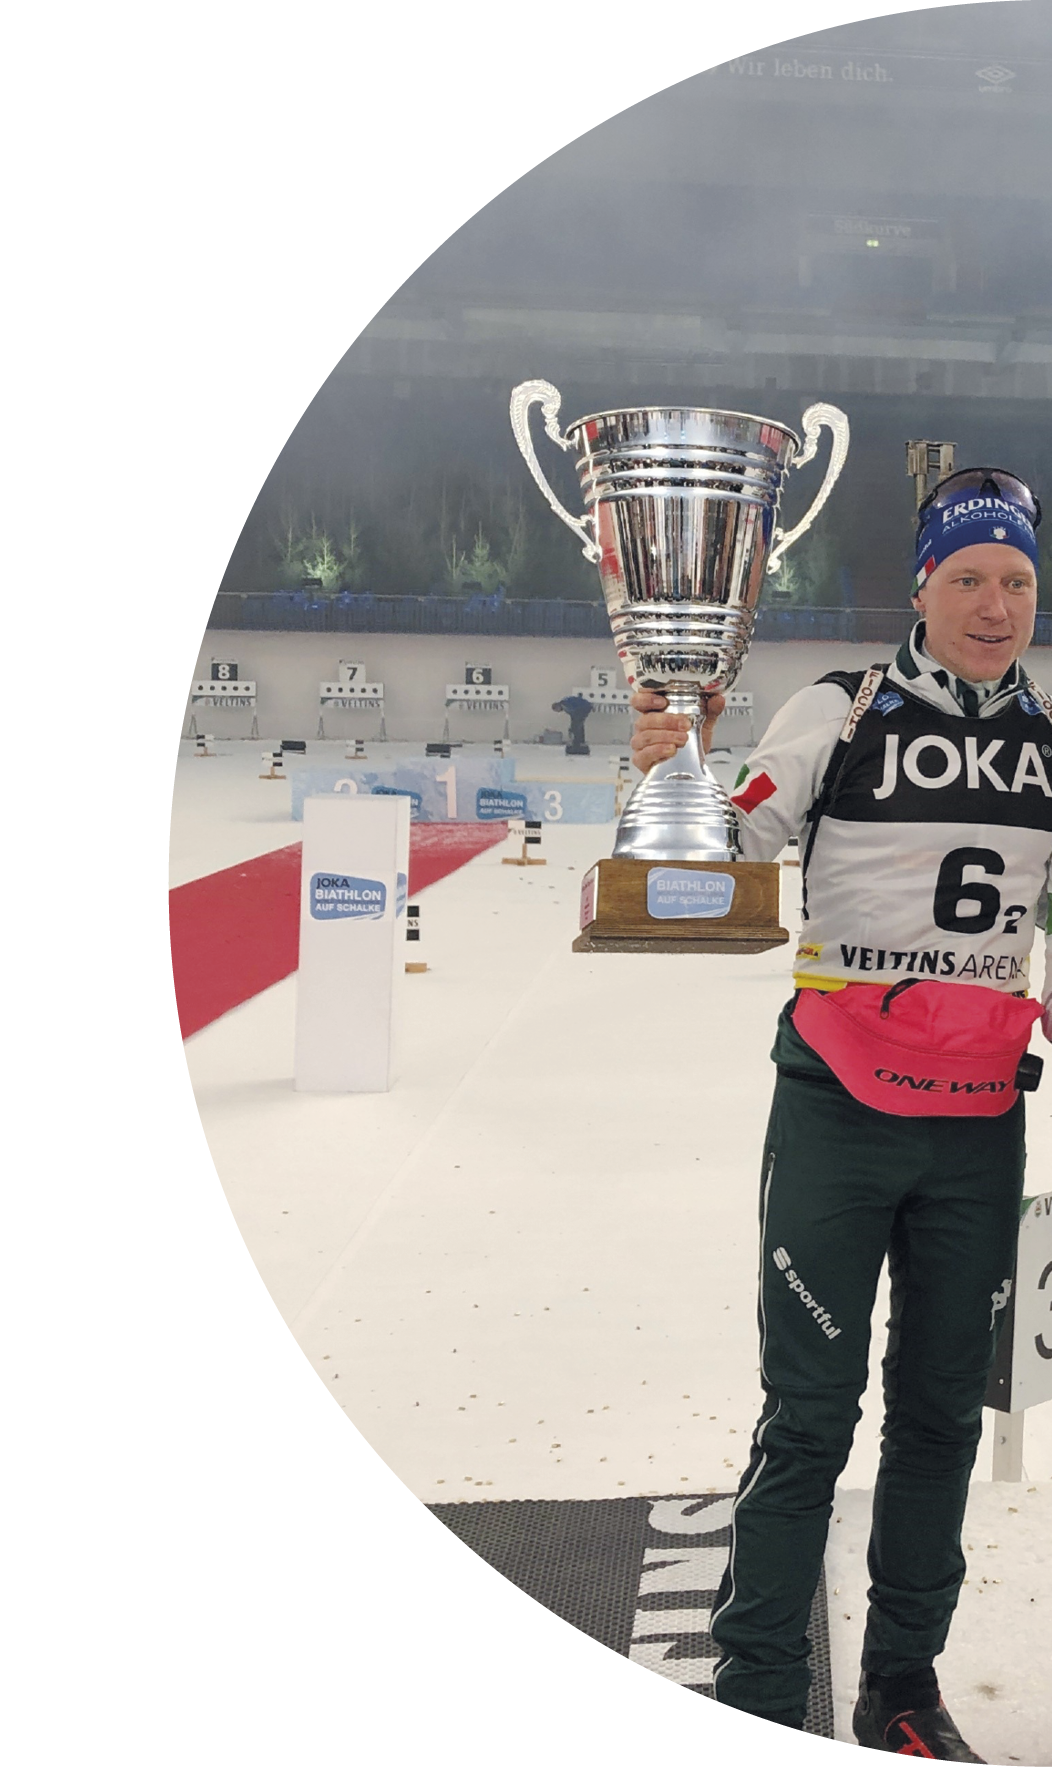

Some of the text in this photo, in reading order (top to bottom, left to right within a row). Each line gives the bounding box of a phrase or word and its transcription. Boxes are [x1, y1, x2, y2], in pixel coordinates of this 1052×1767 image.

[774, 58, 833, 79] leben
[218, 664, 230, 679] 8
[346, 666, 358, 681] 7
[471, 669, 484, 683] 6
[598, 673, 608, 687] 5
[213, 697, 251, 707] VELTINS
[341, 698, 380, 708] VELTINS
[847, 671, 880, 740] FIOCCHI
[436, 765, 458, 819] 1
[480, 798, 523, 807] BIATHLON
[544, 790, 563, 821] 3
[316, 877, 350, 889] JOKA
[656, 879, 726, 892] BIATHLON
[933, 846, 1028, 934] 6 2
[315, 889, 381, 901] BIATHLON
[656, 895, 725, 905] AUF SCHALKE
[315, 903, 381, 912] AUF SCHALKE
[785, 1269, 842, 1340] sportful
